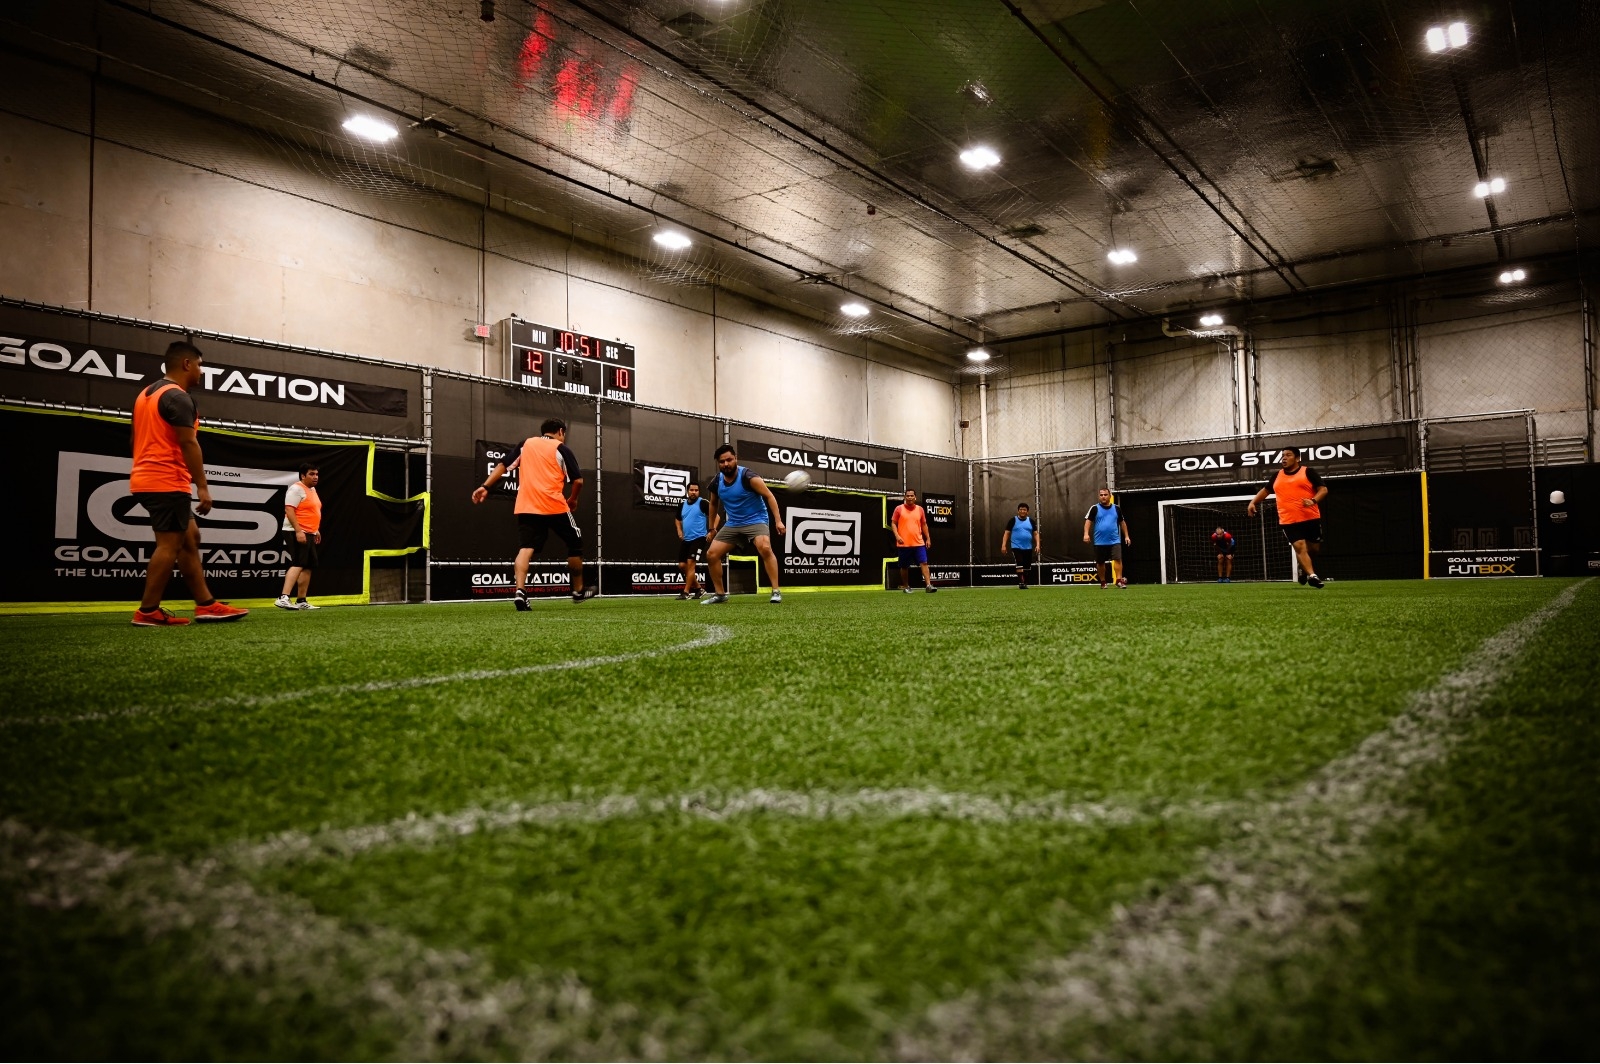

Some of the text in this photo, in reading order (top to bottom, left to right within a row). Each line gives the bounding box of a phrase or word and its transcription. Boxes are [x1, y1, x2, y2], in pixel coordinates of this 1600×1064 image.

[532, 329, 547, 345] MIN
[605, 345, 619, 360] SEC
[526, 351, 542, 373] 12
[0, 336, 345, 406] GOAL TATION
[616, 369, 628, 389] 10
[521, 374, 543, 388] HOME
[767, 447, 877, 475] GOAL STATION
[1164, 455, 1235, 472] GOAL
[794, 520, 853, 555] GS
[54, 545, 293, 565] GOAL TATION
[784, 556, 860, 567] GOAL STATION
[54, 568, 87, 577] THE
[91, 568, 148, 578] ULTIMA
[241, 569, 287, 578] SYSTE
[631, 572, 662, 583] GOAL
[1052, 573, 1099, 583] FUTBOX
[1448, 564, 1516, 575] FUTBOX
[471, 572, 571, 585] GOAL TATION
